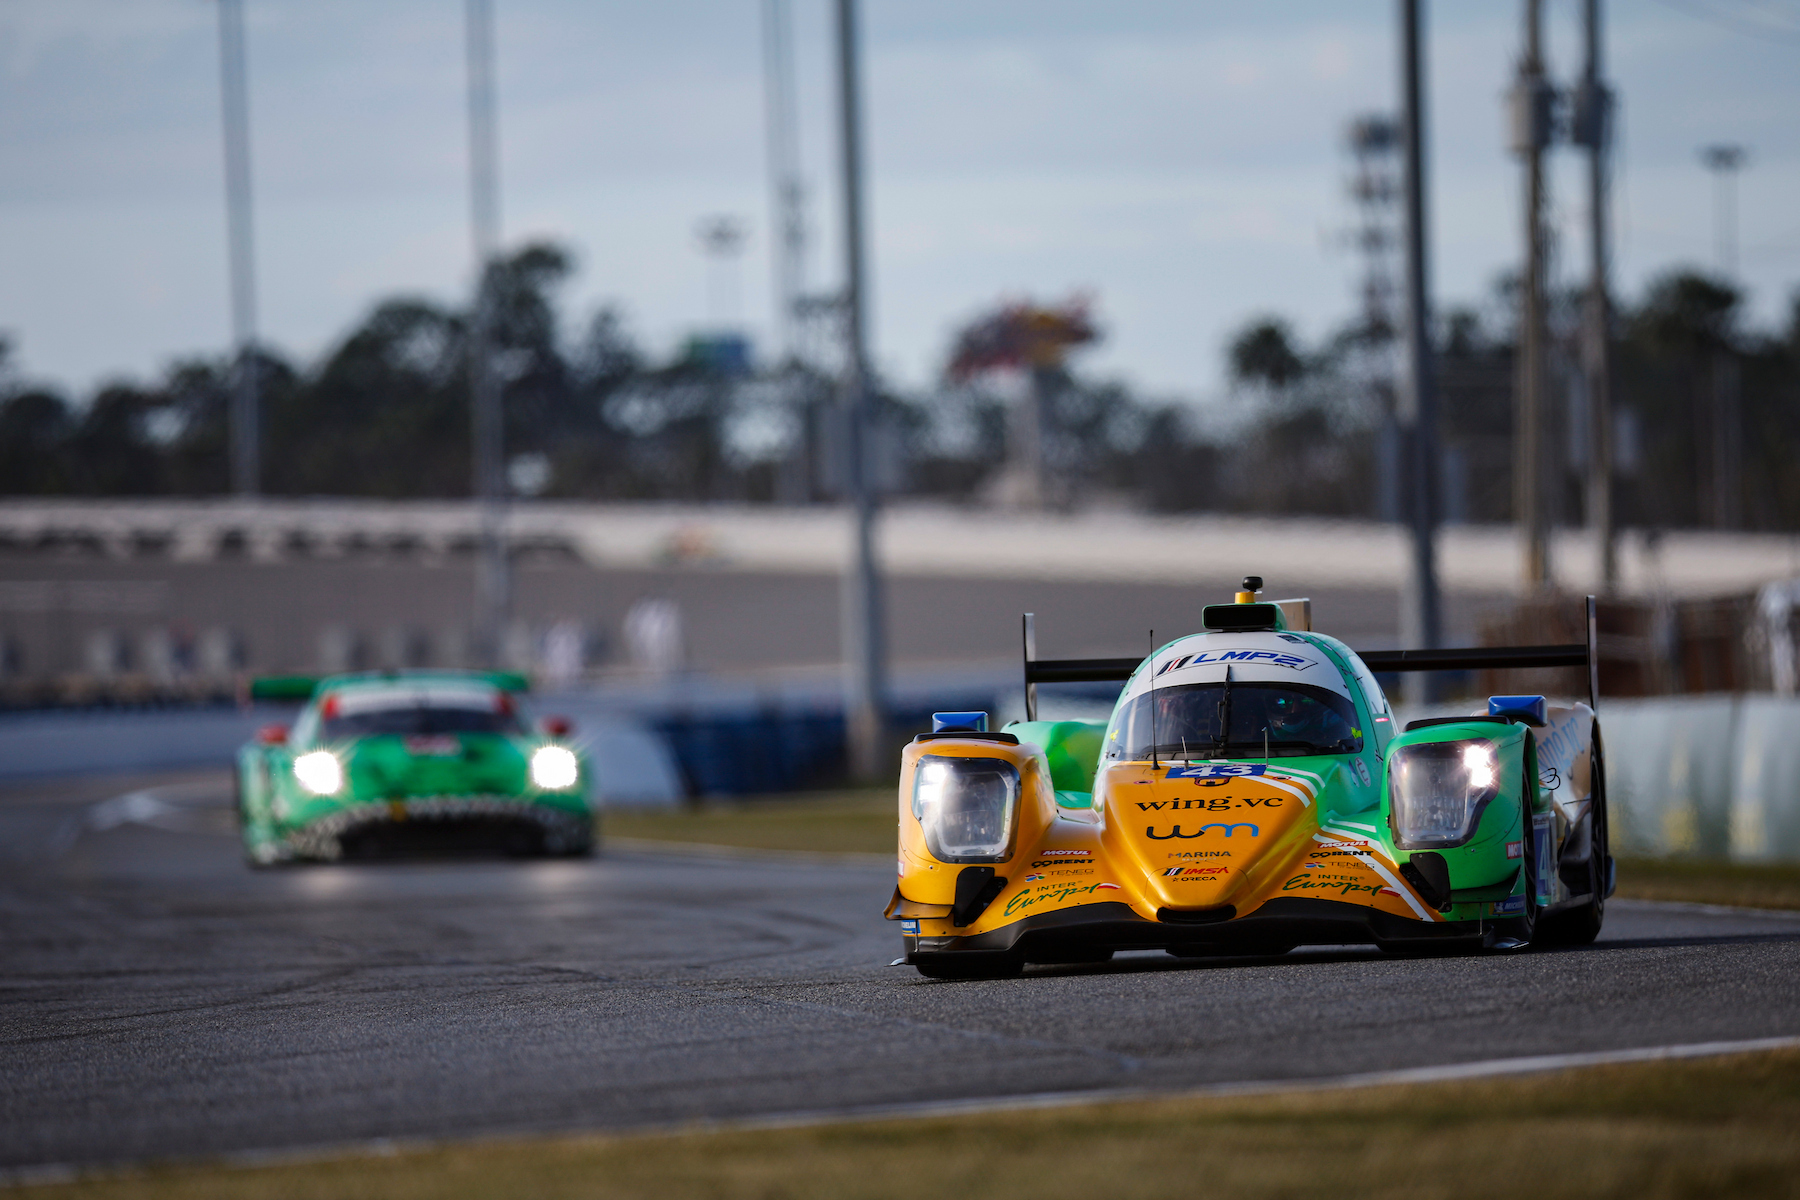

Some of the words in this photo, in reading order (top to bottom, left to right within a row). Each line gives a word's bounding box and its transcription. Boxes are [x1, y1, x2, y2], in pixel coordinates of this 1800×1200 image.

[1192, 651, 1305, 666] LMP2
[1180, 765, 1252, 776] 43
[1135, 796, 1283, 811] wing.vc
[1282, 873, 1383, 896] Europol
[1318, 874, 1358, 882] INTER
[1037, 882, 1076, 892] INTER
[1003, 882, 1101, 917] Europol
